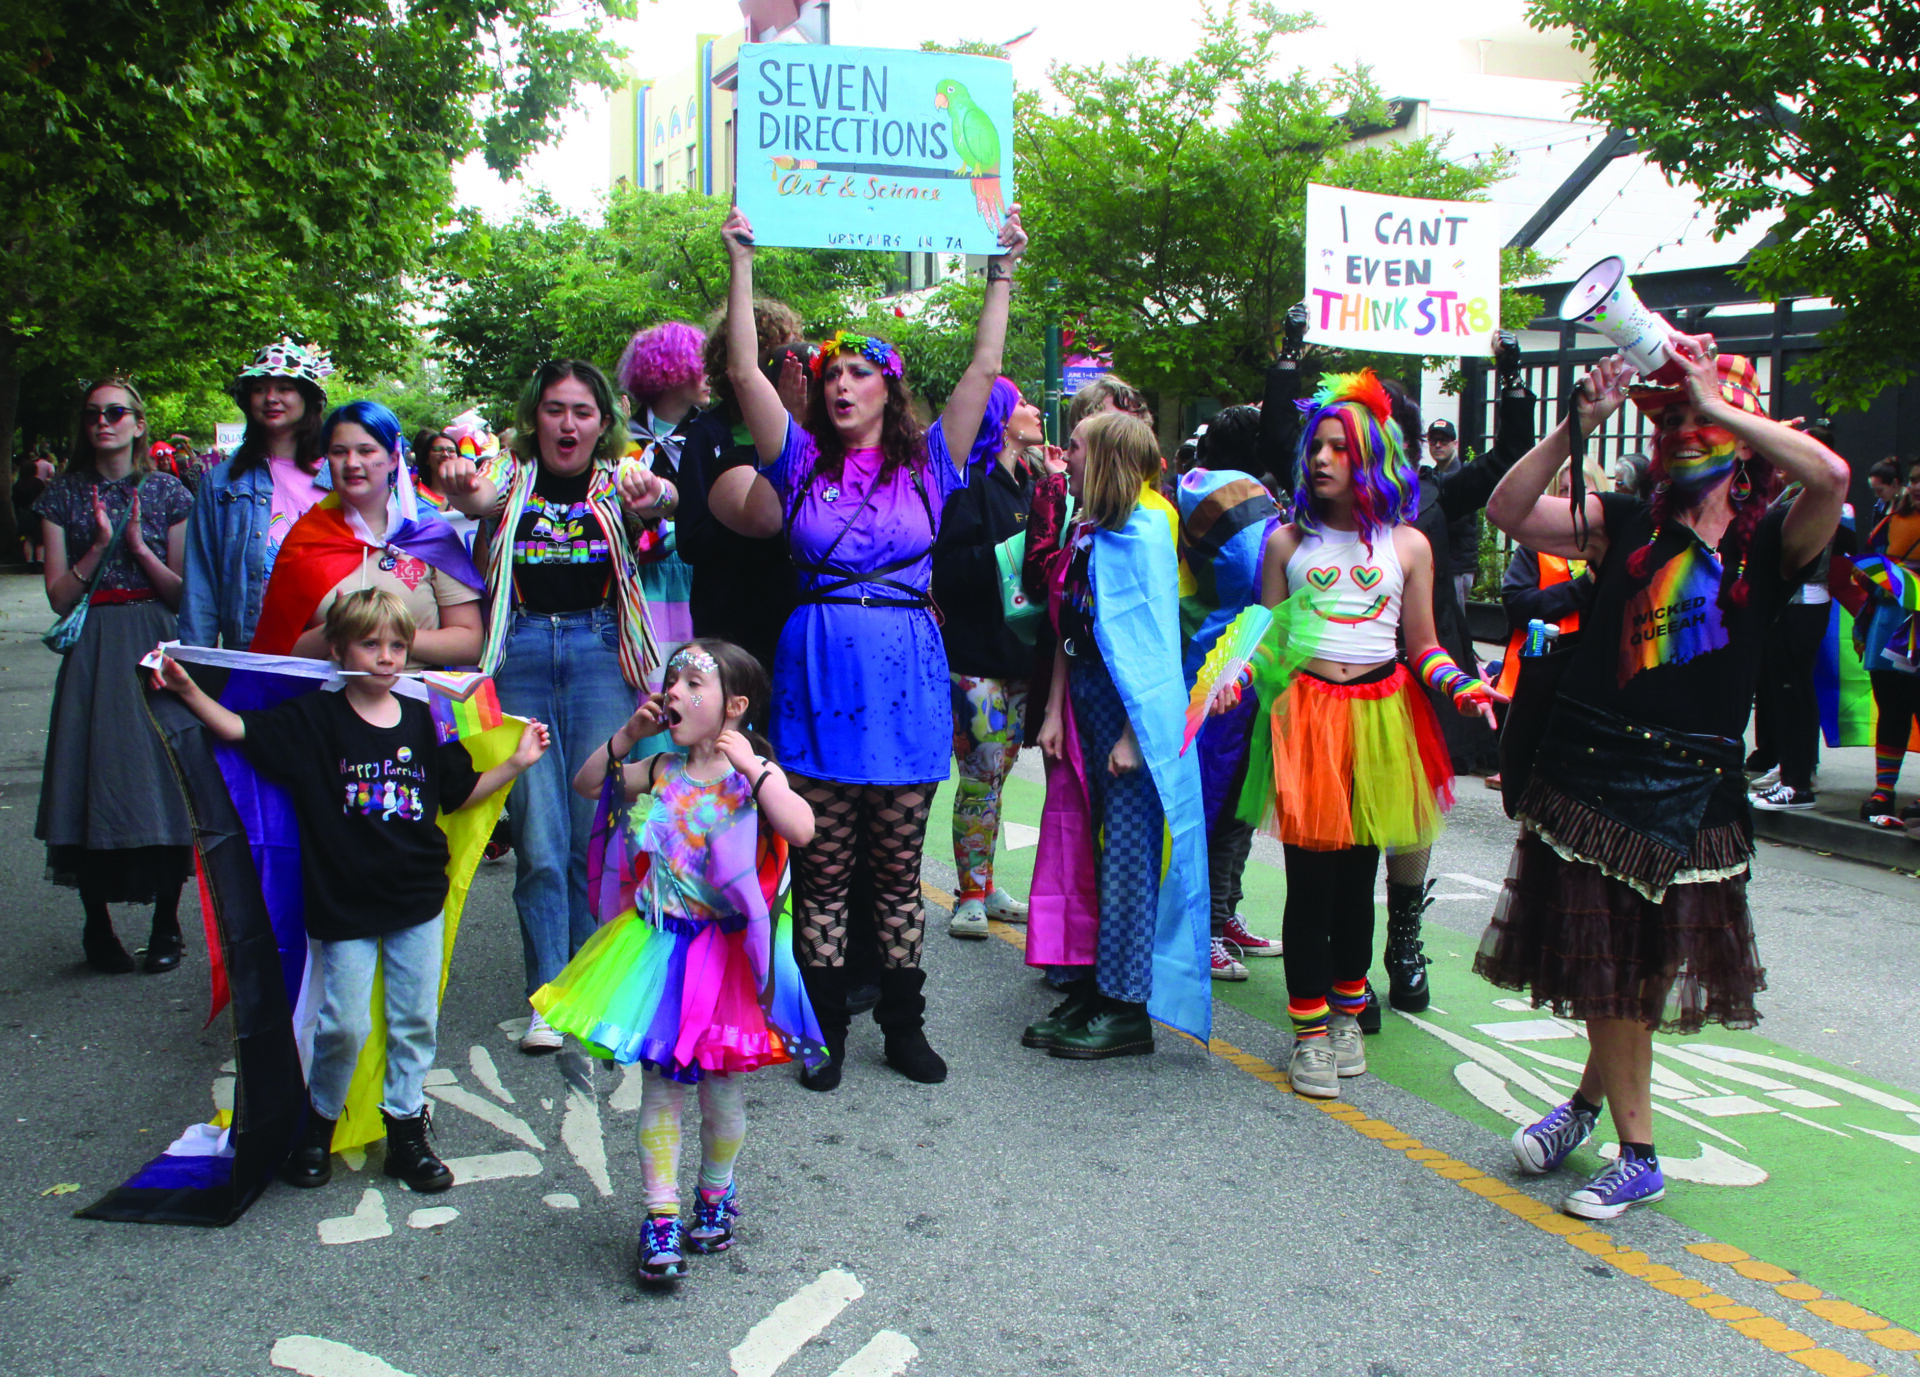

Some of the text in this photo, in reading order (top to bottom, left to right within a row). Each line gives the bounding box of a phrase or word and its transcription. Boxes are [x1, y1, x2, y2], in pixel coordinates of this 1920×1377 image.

[758, 59, 888, 112] SEVEN
[759, 112, 948, 160] DIRECTIONS
[838, 174, 856, 198] &
[863, 176, 943, 201] Science
[828, 233, 963, 249] UPSTAIRS IN 7A
[1340, 205, 1468, 246] I CAN'T
[1346, 255, 1431, 287] EVEN
[1312, 288, 1493, 336] THINK STR8
[1633, 596, 1706, 627] WICKED
[1630, 612, 1706, 646] QUEEAH
[340, 758, 380, 778] Happy
